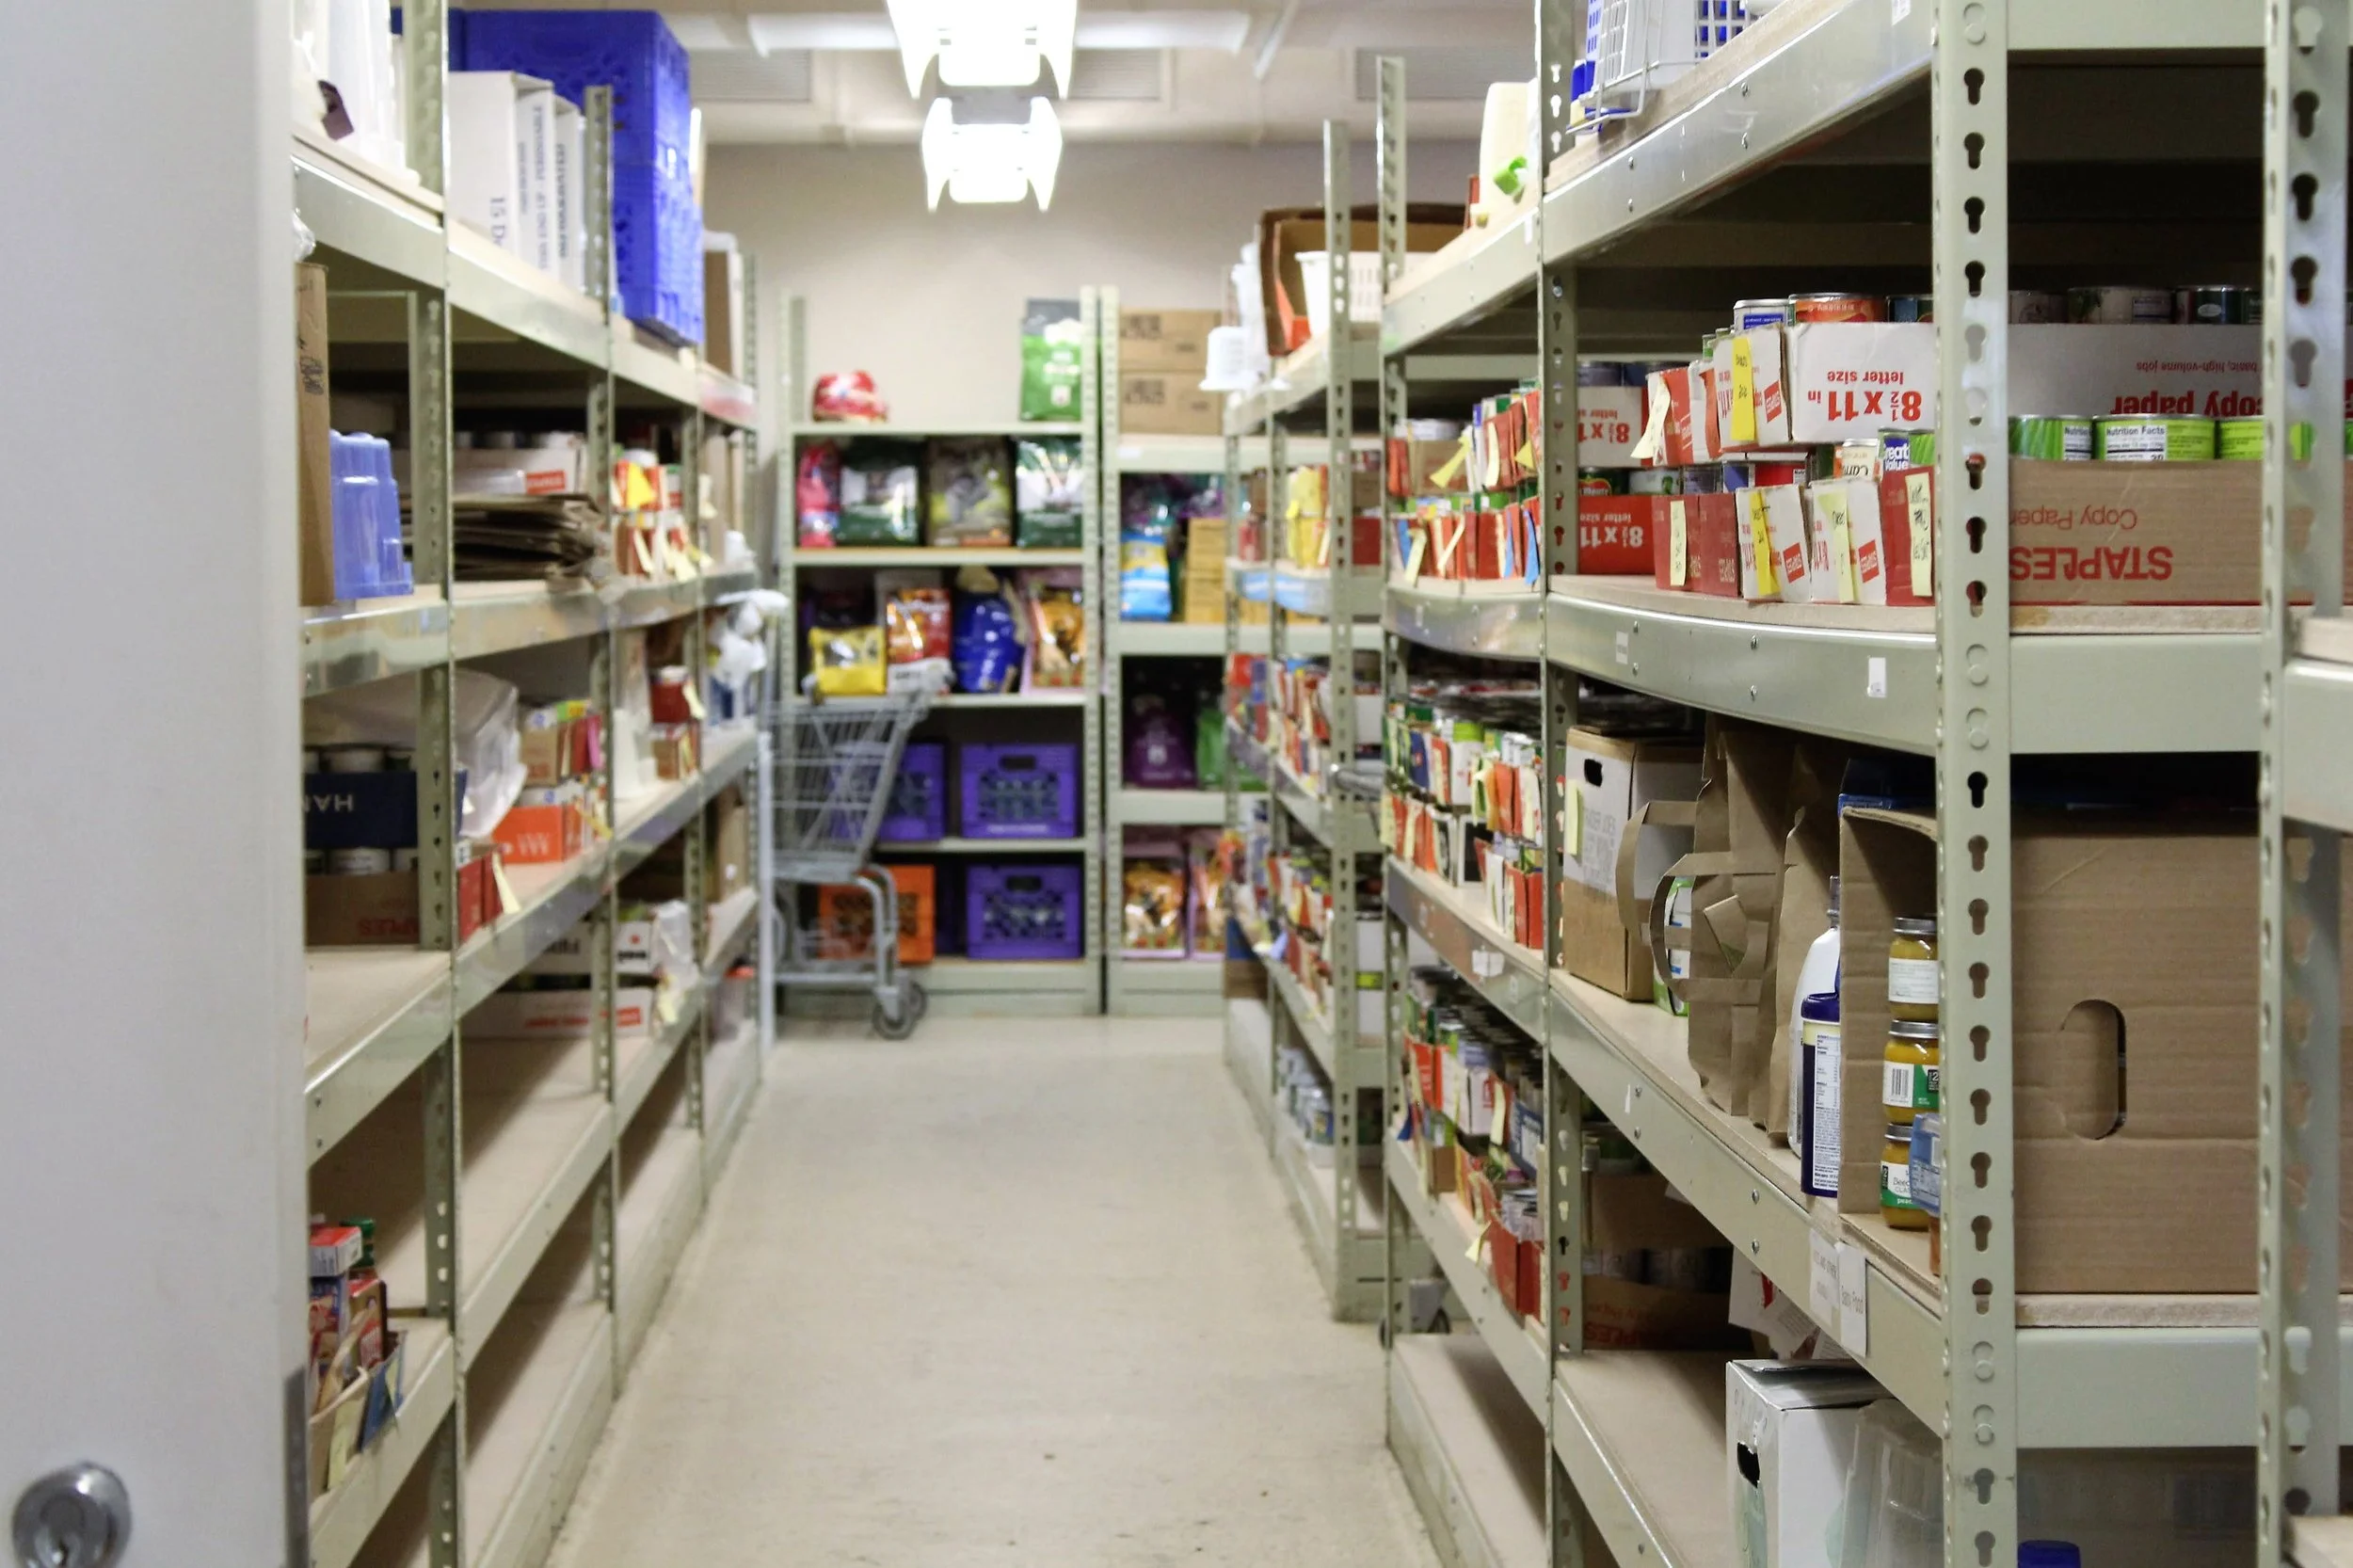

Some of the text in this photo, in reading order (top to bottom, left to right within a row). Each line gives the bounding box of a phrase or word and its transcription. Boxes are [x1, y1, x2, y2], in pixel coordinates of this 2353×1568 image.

[2136, 360, 2158, 373] jobs
[1827, 371, 1904, 385] letter size
[1807, 390, 1821, 405] in
[2109, 391, 2263, 418] opy paper
[1828, 390, 1859, 422] 11
[1590, 409, 1619, 420] letter
[2106, 425, 2166, 436] Nutrition Facts
[1603, 513, 1632, 523] letter
[2009, 504, 2137, 530] Copy Paper
[2009, 546, 2174, 581] STAPLES
